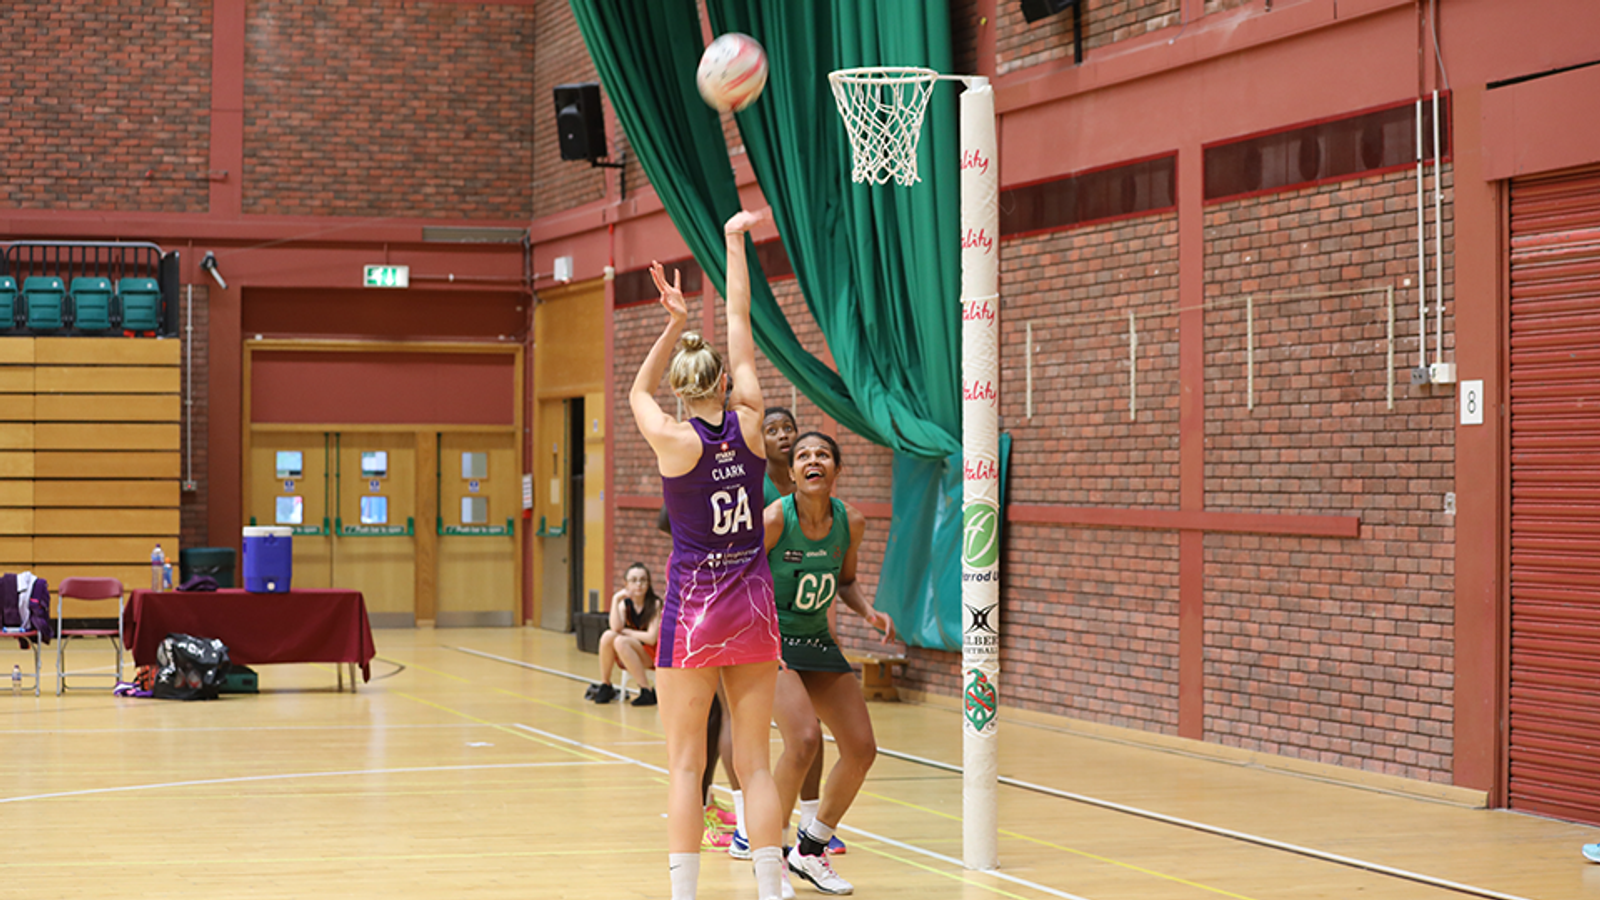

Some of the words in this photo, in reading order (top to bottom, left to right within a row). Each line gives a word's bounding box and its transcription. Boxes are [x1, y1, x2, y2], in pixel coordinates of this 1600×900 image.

[1467, 390, 1476, 414] 8
[711, 464, 746, 481] CLARK
[710, 487, 753, 535] GA
[795, 573, 835, 610] GD
